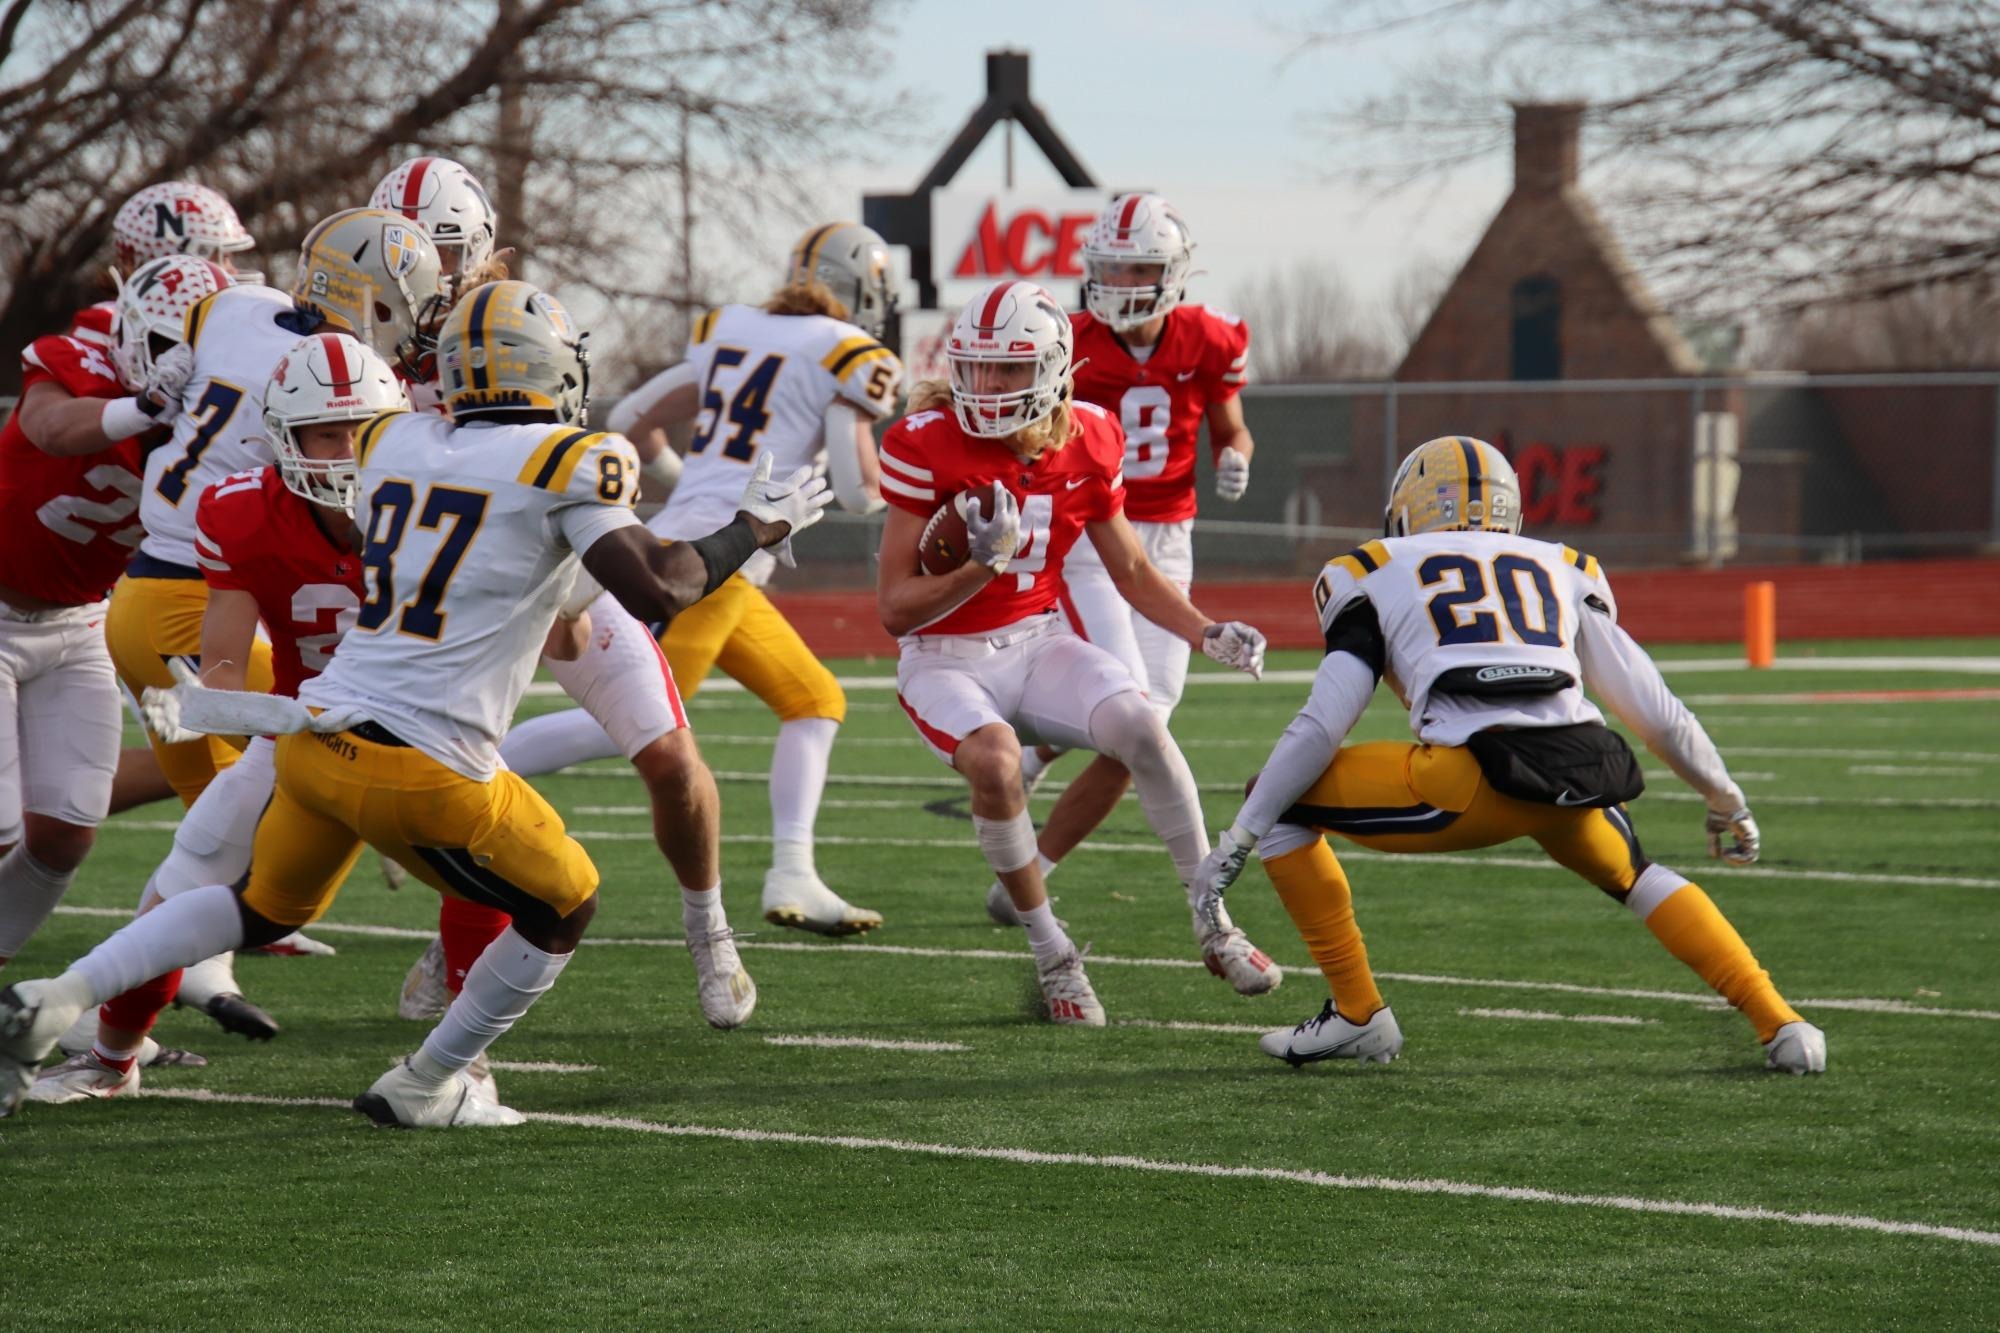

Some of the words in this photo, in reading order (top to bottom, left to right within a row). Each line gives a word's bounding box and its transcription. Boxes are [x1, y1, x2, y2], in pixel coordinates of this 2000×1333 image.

[954, 200, 1095, 277] ACE
[155, 376, 246, 509] 7
[688, 345, 786, 465] 54
[1120, 385, 1172, 480] 8
[1495, 434, 1604, 526] CE
[356, 477, 493, 643] 87
[1003, 494, 1053, 593] 4
[1416, 550, 1567, 648] 20
